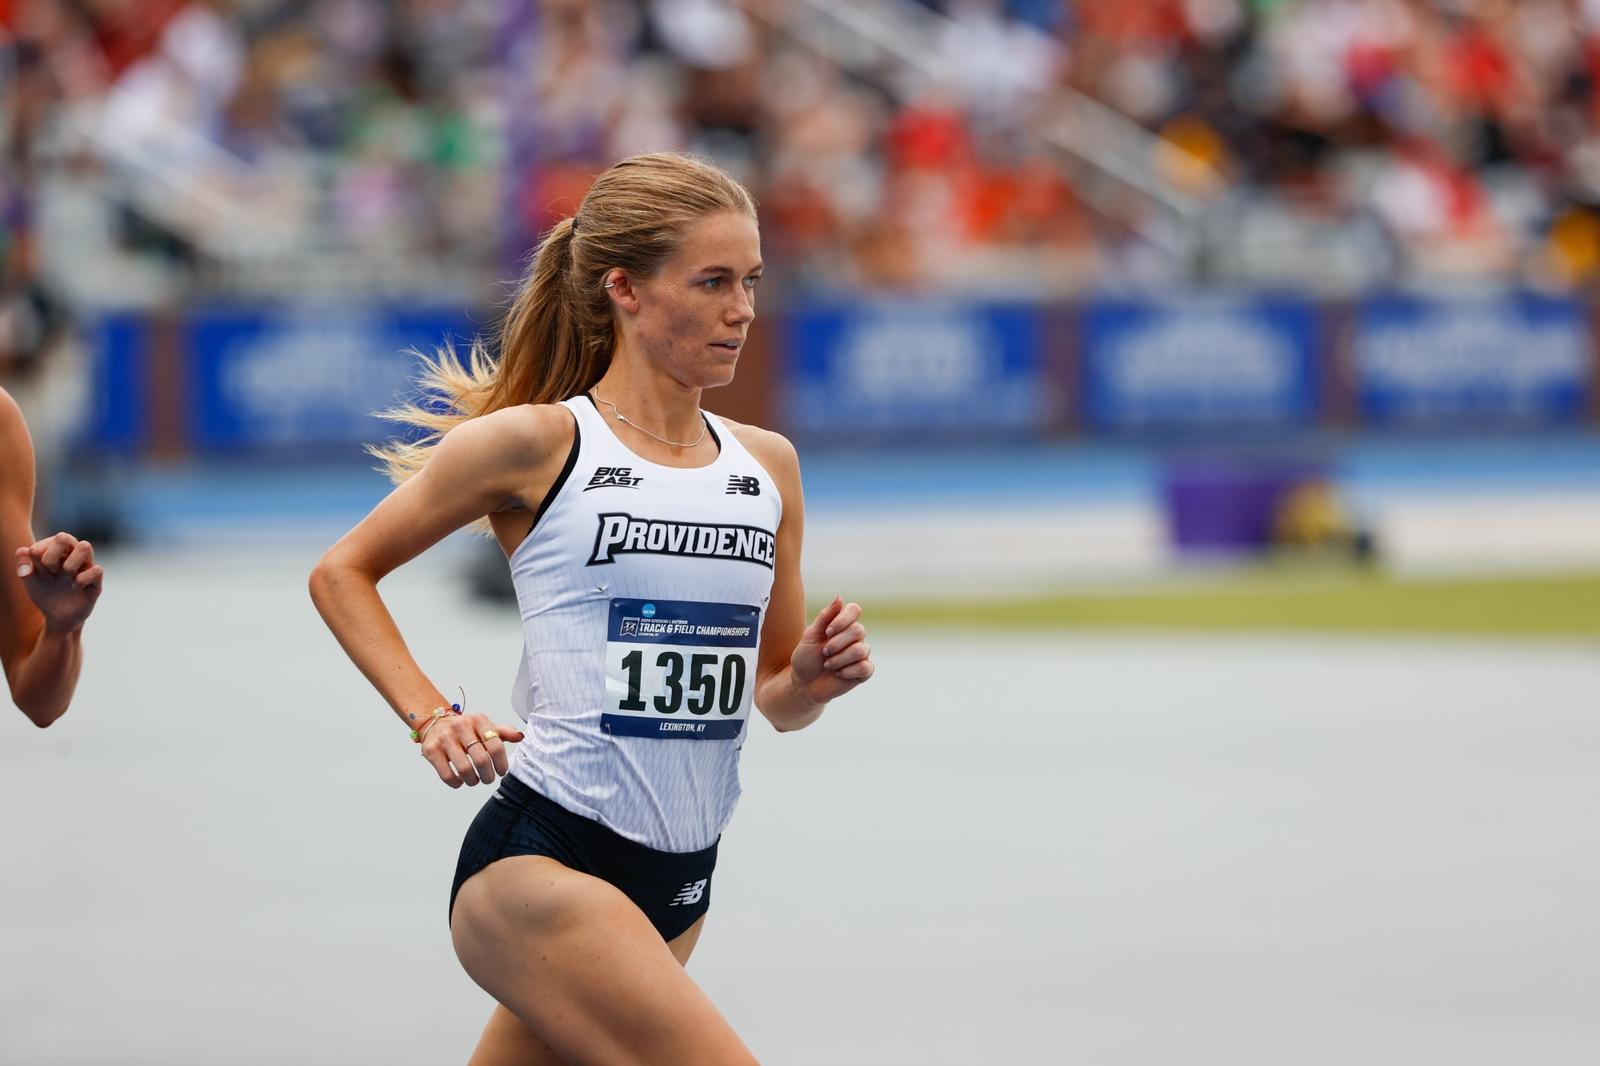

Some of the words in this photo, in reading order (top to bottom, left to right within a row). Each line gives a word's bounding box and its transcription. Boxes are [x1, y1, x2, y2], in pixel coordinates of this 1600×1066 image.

[594, 467, 632, 476] BIG
[588, 477, 643, 486] EAST
[584, 512, 775, 570] PROVIDENCE
[639, 623, 666, 633] TRACK
[666, 624, 674, 633] &
[673, 624, 695, 634] FIELD
[696, 626, 750, 636] CHAMPIONSHIPS
[619, 650, 746, 716] 1350
[660, 722, 696, 732] LEXINGTON,
[696, 724, 706, 732] KY
